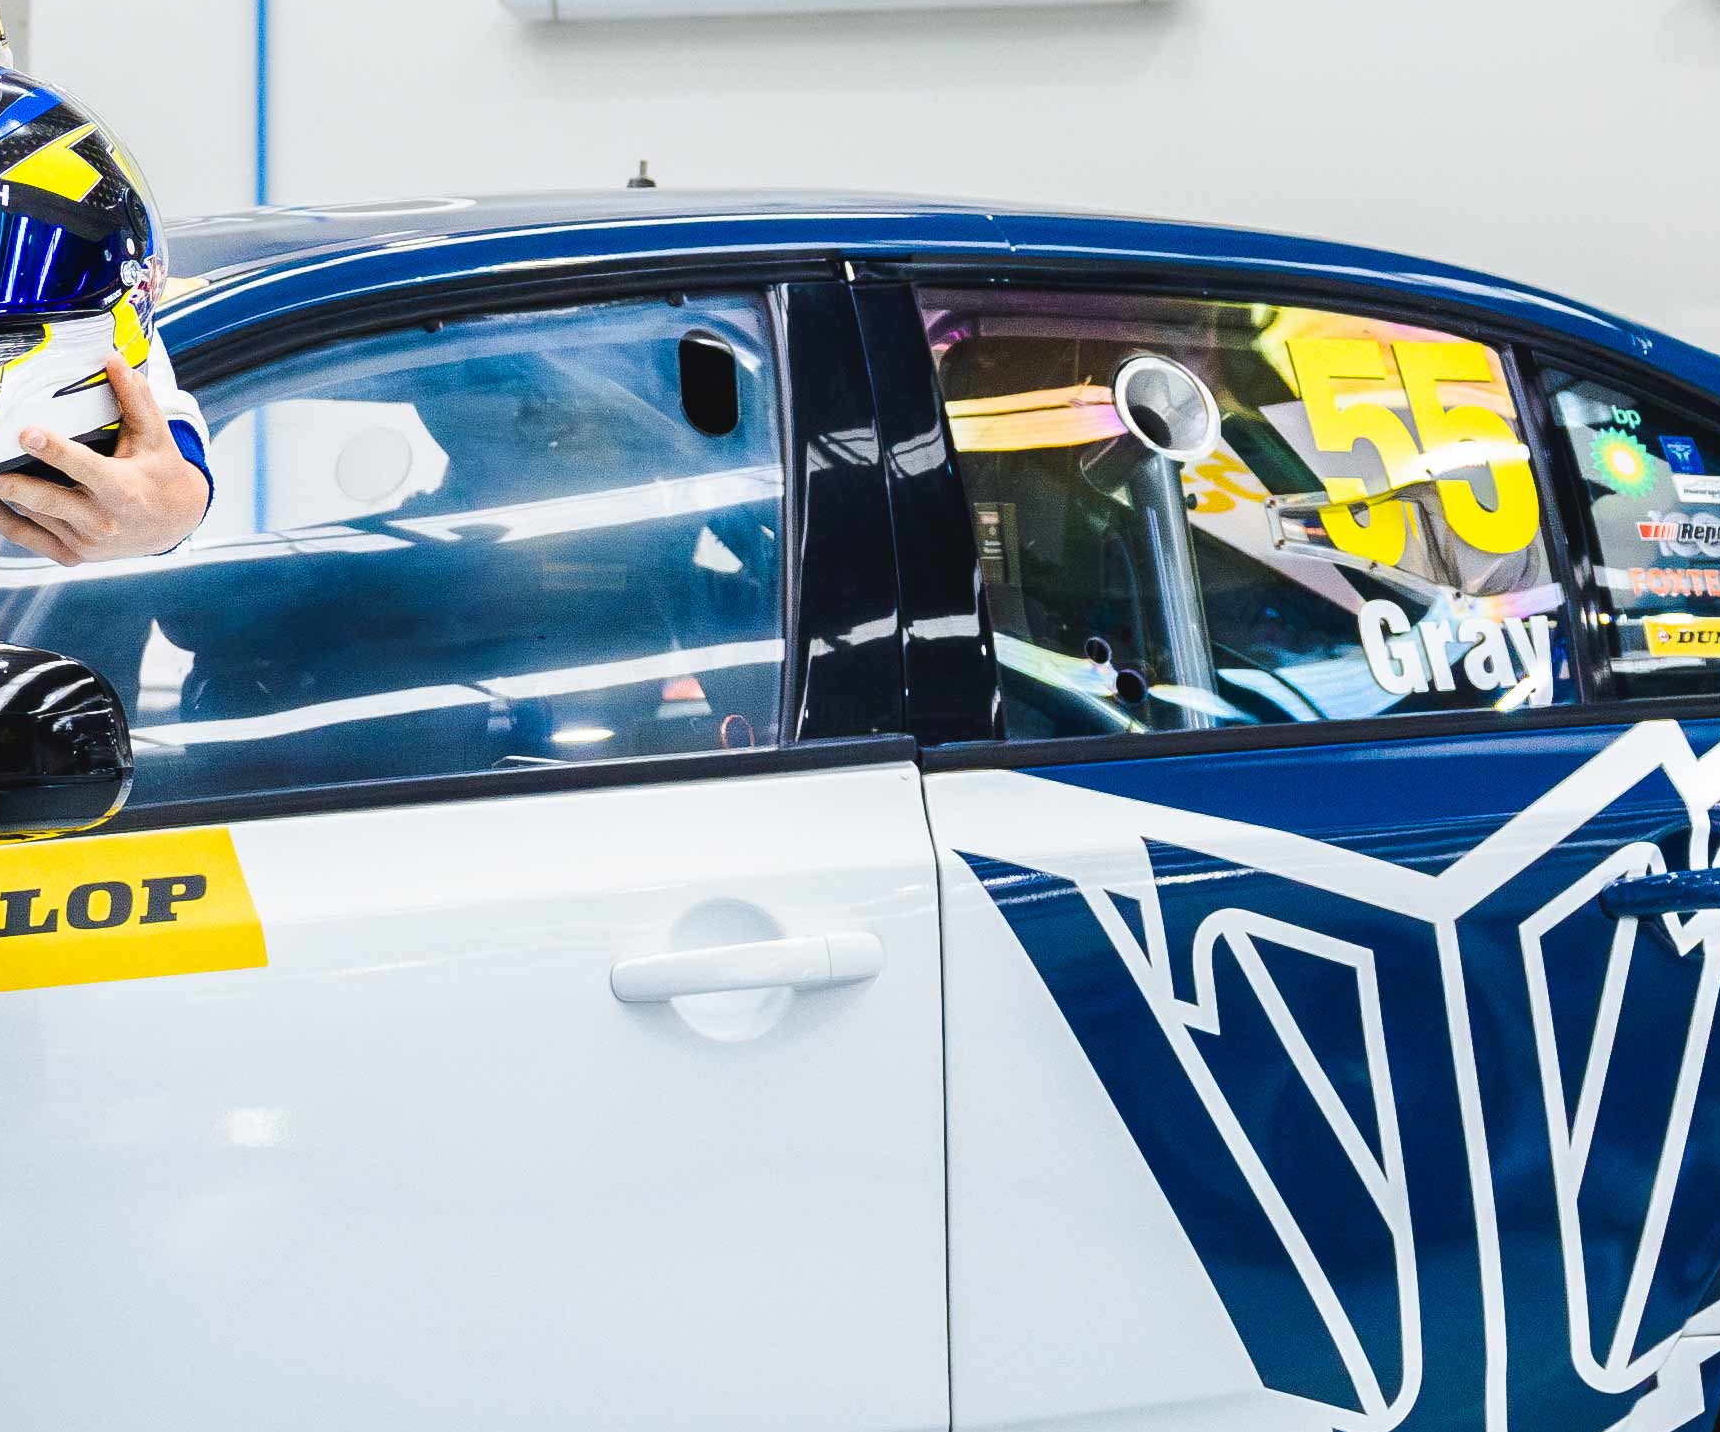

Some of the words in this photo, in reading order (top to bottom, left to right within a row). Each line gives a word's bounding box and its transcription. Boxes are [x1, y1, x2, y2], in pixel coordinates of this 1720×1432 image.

[1286, 339, 1541, 567] 55
[1611, 405, 1642, 429] bp
[1359, 598, 1554, 707] Gray
